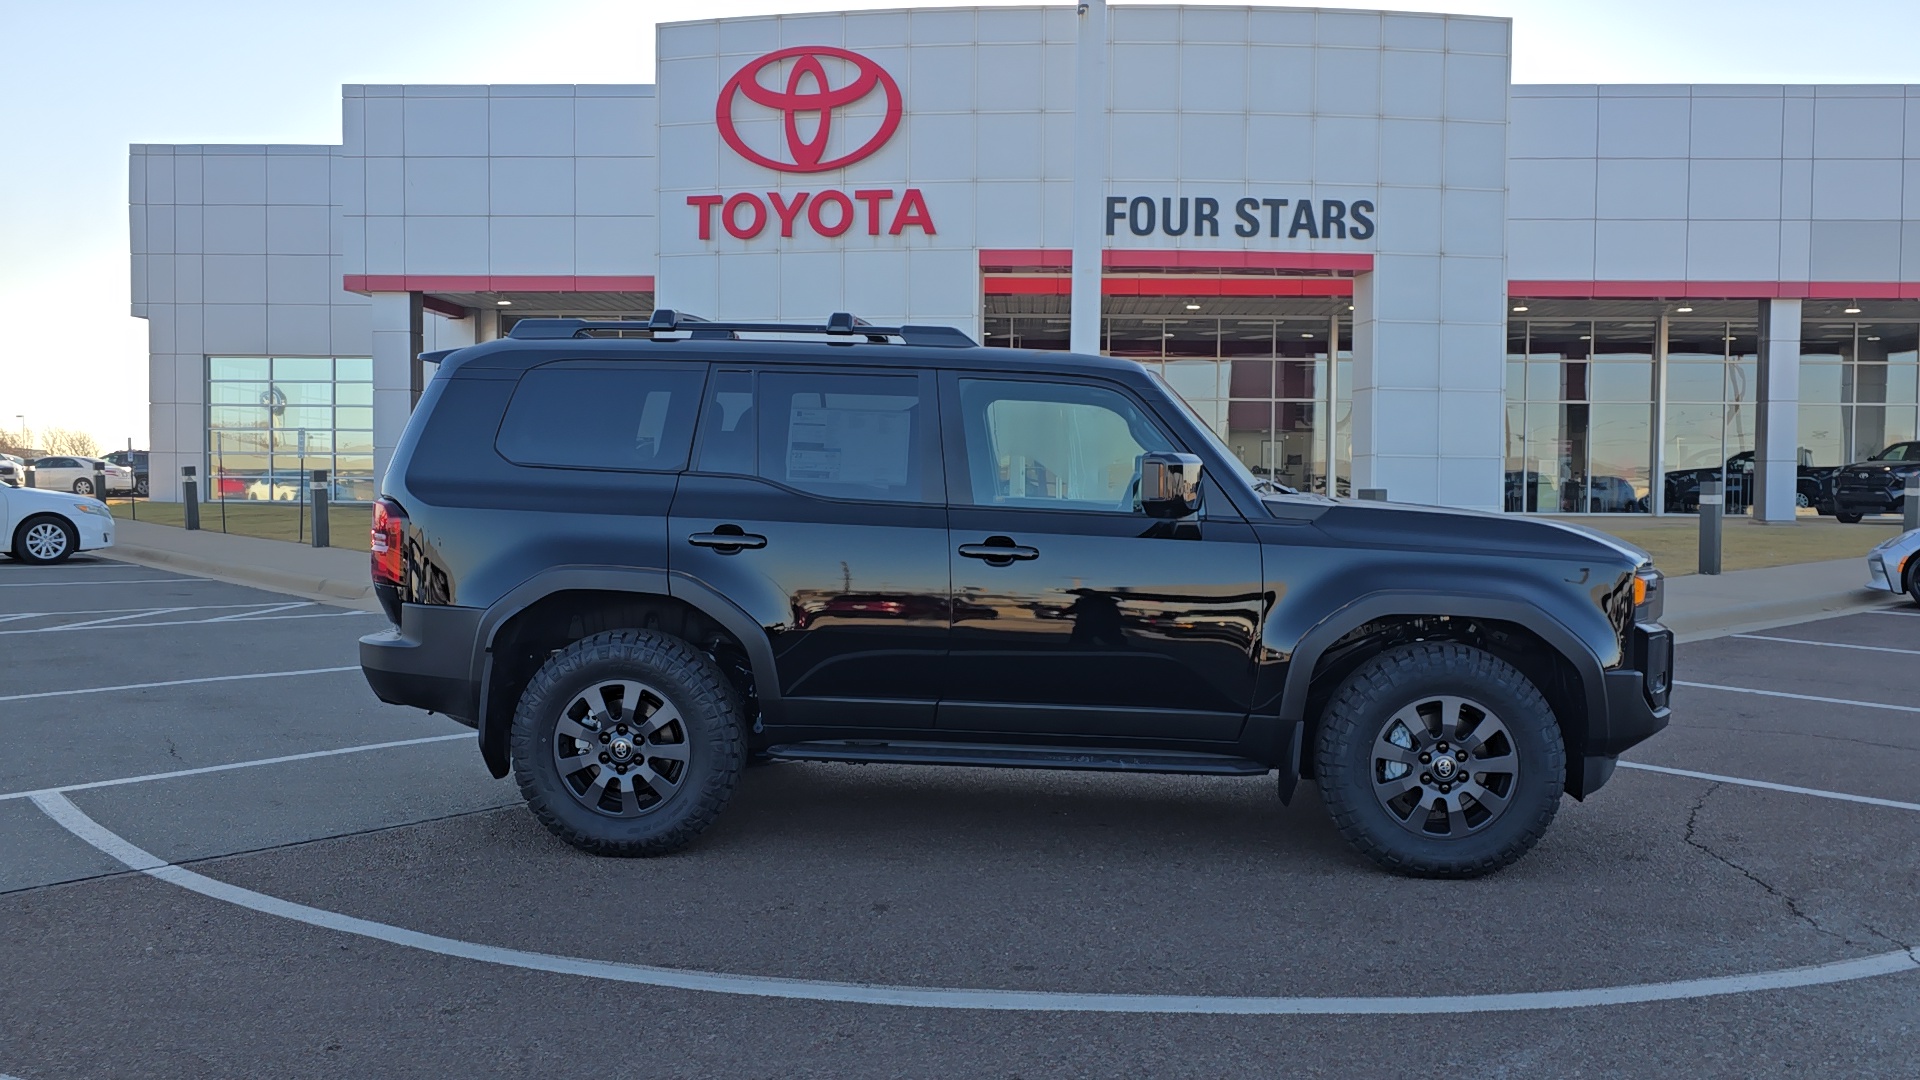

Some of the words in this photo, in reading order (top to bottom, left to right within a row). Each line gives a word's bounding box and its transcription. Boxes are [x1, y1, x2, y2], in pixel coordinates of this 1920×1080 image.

[687, 188, 937, 241] TOYOTA
[1105, 196, 1220, 237] FOUR
[1234, 197, 1375, 240] STARS
